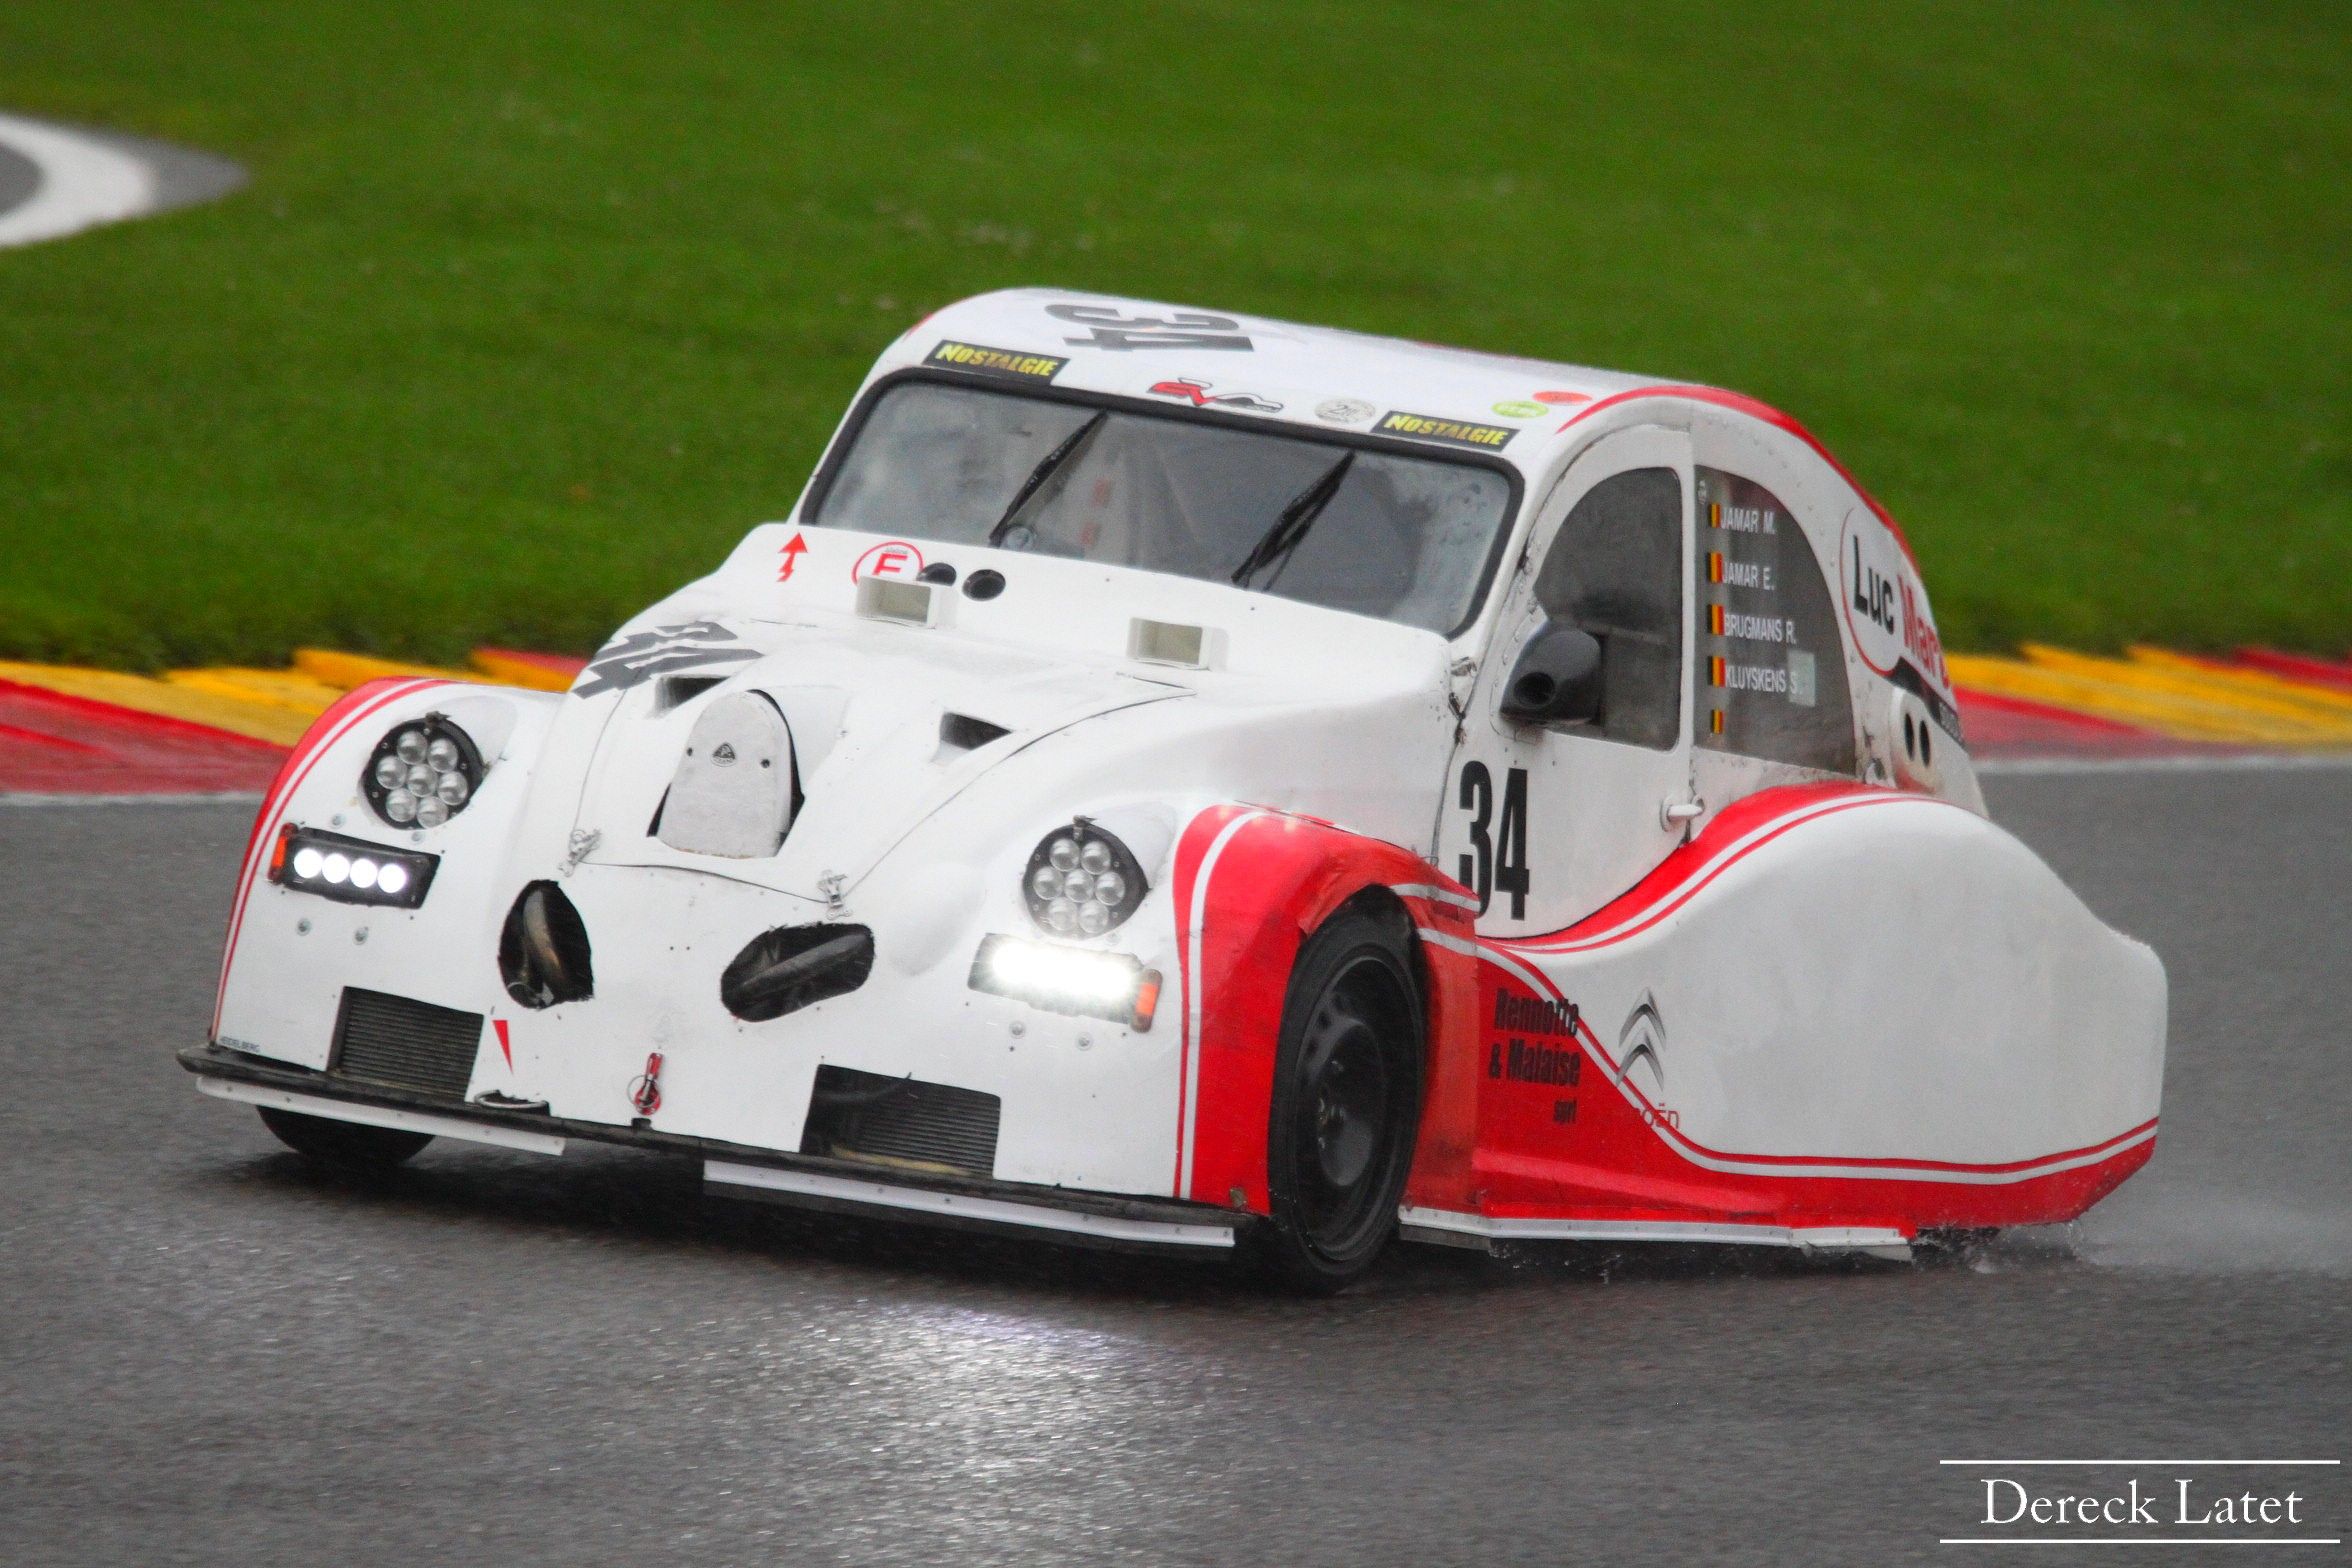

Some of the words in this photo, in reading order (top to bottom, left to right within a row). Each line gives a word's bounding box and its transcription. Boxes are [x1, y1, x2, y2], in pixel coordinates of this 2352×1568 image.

[935, 344, 1058, 376] NOSTALGIE
[1383, 414, 1509, 446] NOSTALGIE
[1721, 507, 1759, 533] JAMAR
[1762, 510, 1776, 535] M.
[1722, 561, 1759, 588] JAMAR
[1763, 567, 1775, 591] E.
[1724, 613, 1783, 642] BRUGMANS
[1786, 621, 1797, 645] R.
[1725, 665, 1787, 693] KLUYSKENS
[1458, 761, 1530, 921] 34
[1506, 1038, 1580, 1087] Malaise
